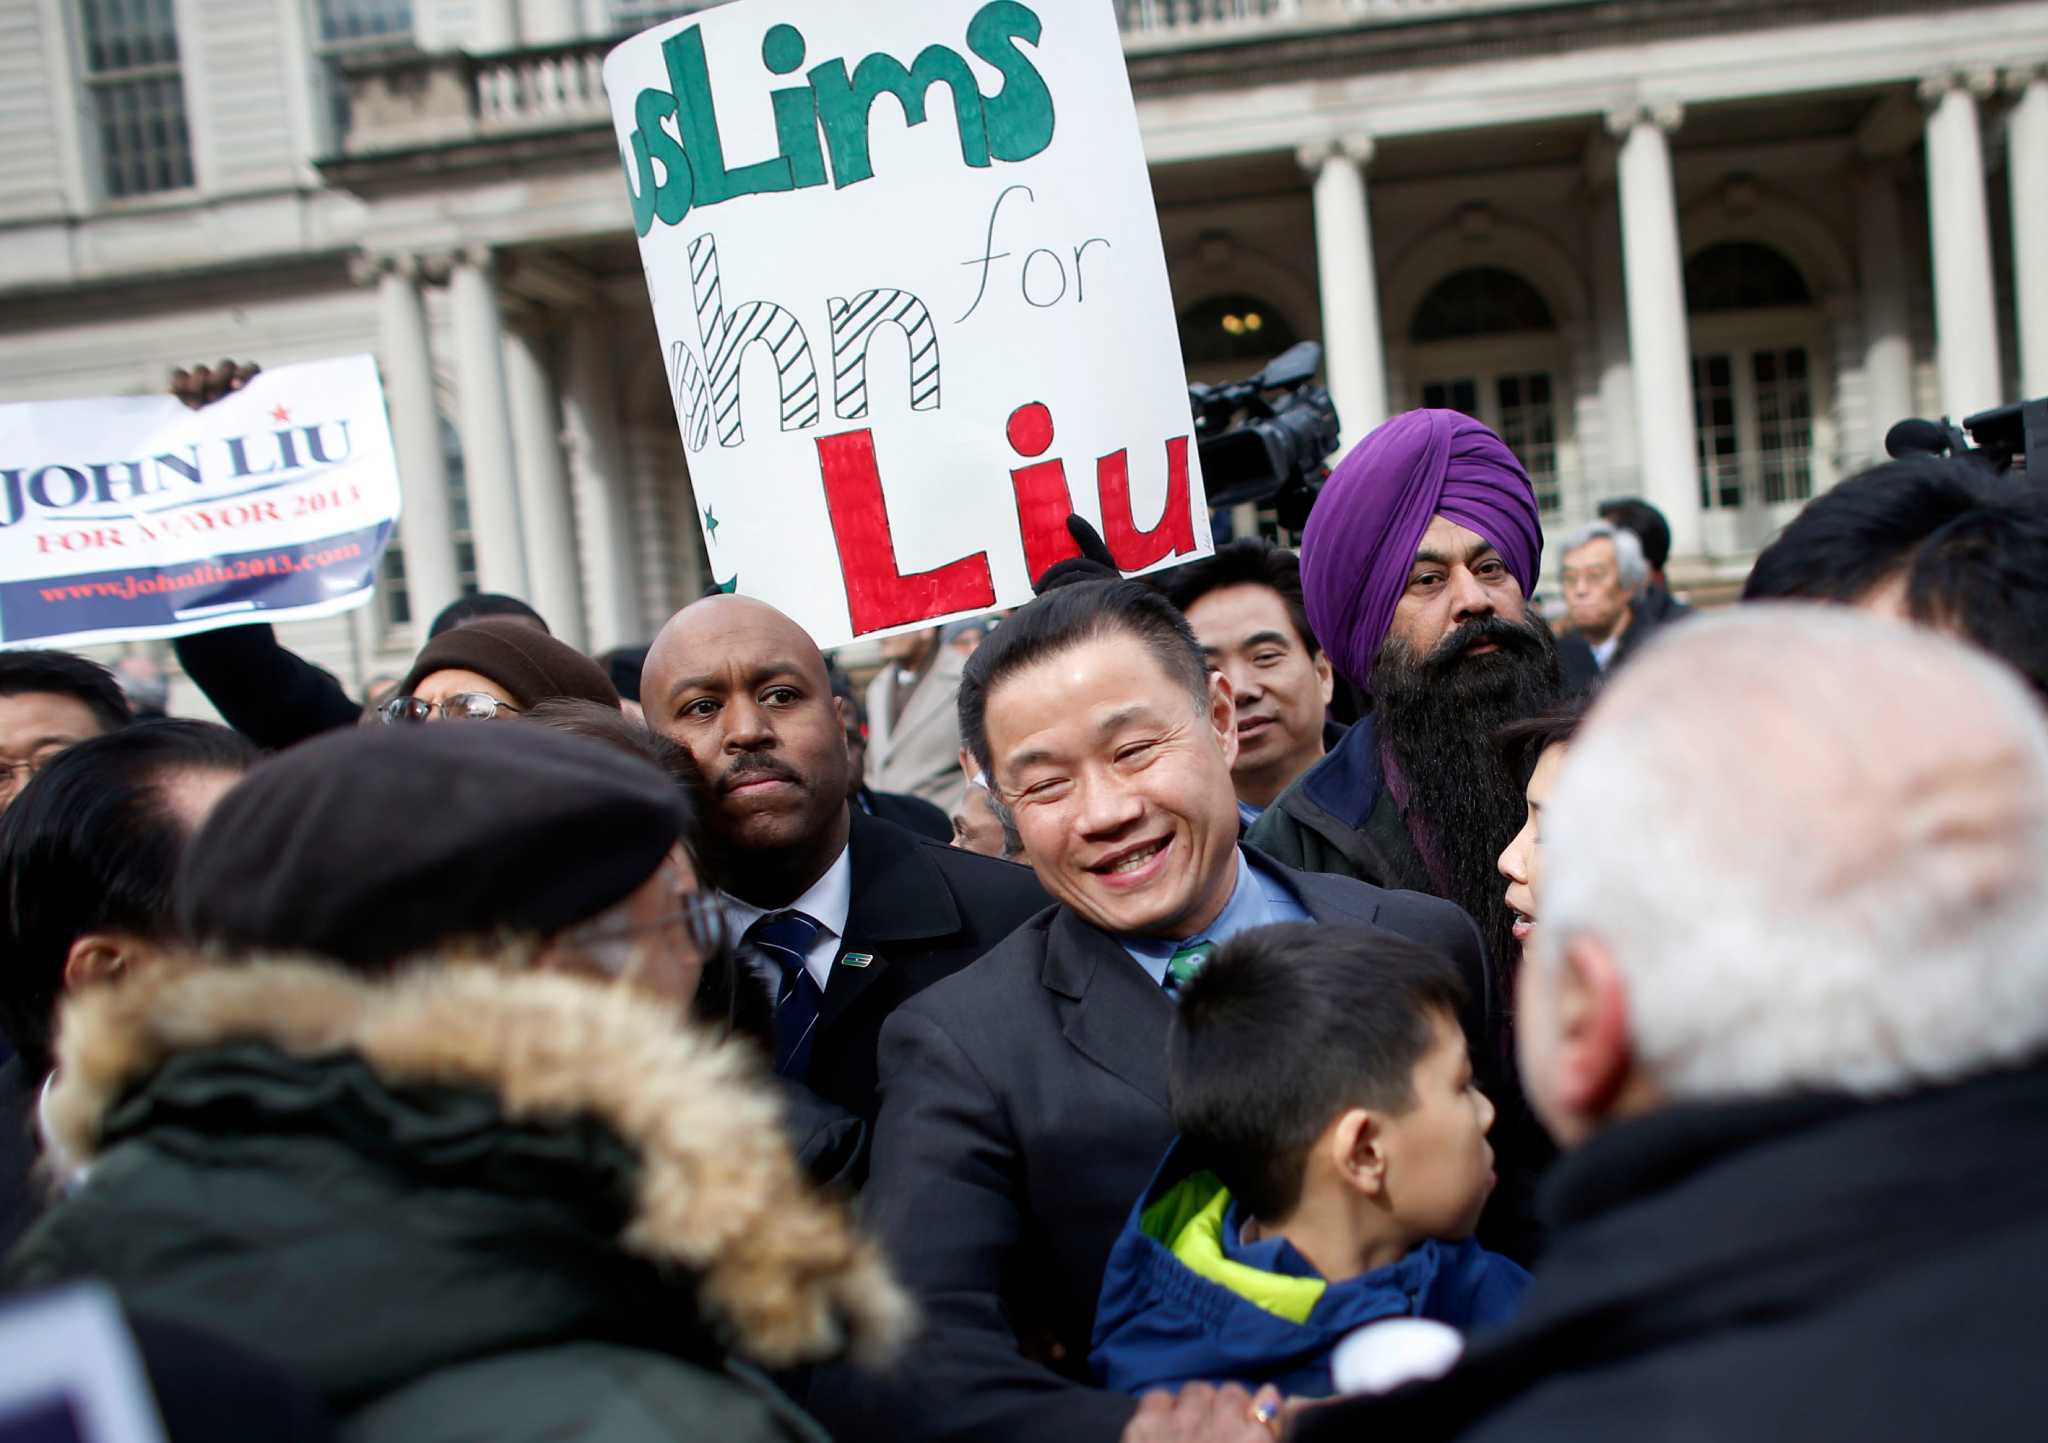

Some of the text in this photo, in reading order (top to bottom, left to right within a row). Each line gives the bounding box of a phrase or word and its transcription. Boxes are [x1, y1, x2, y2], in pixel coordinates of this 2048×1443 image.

[955, 185, 1111, 323] for
[36, 527, 126, 552] FOR
[814, 401, 1197, 637] Liu
